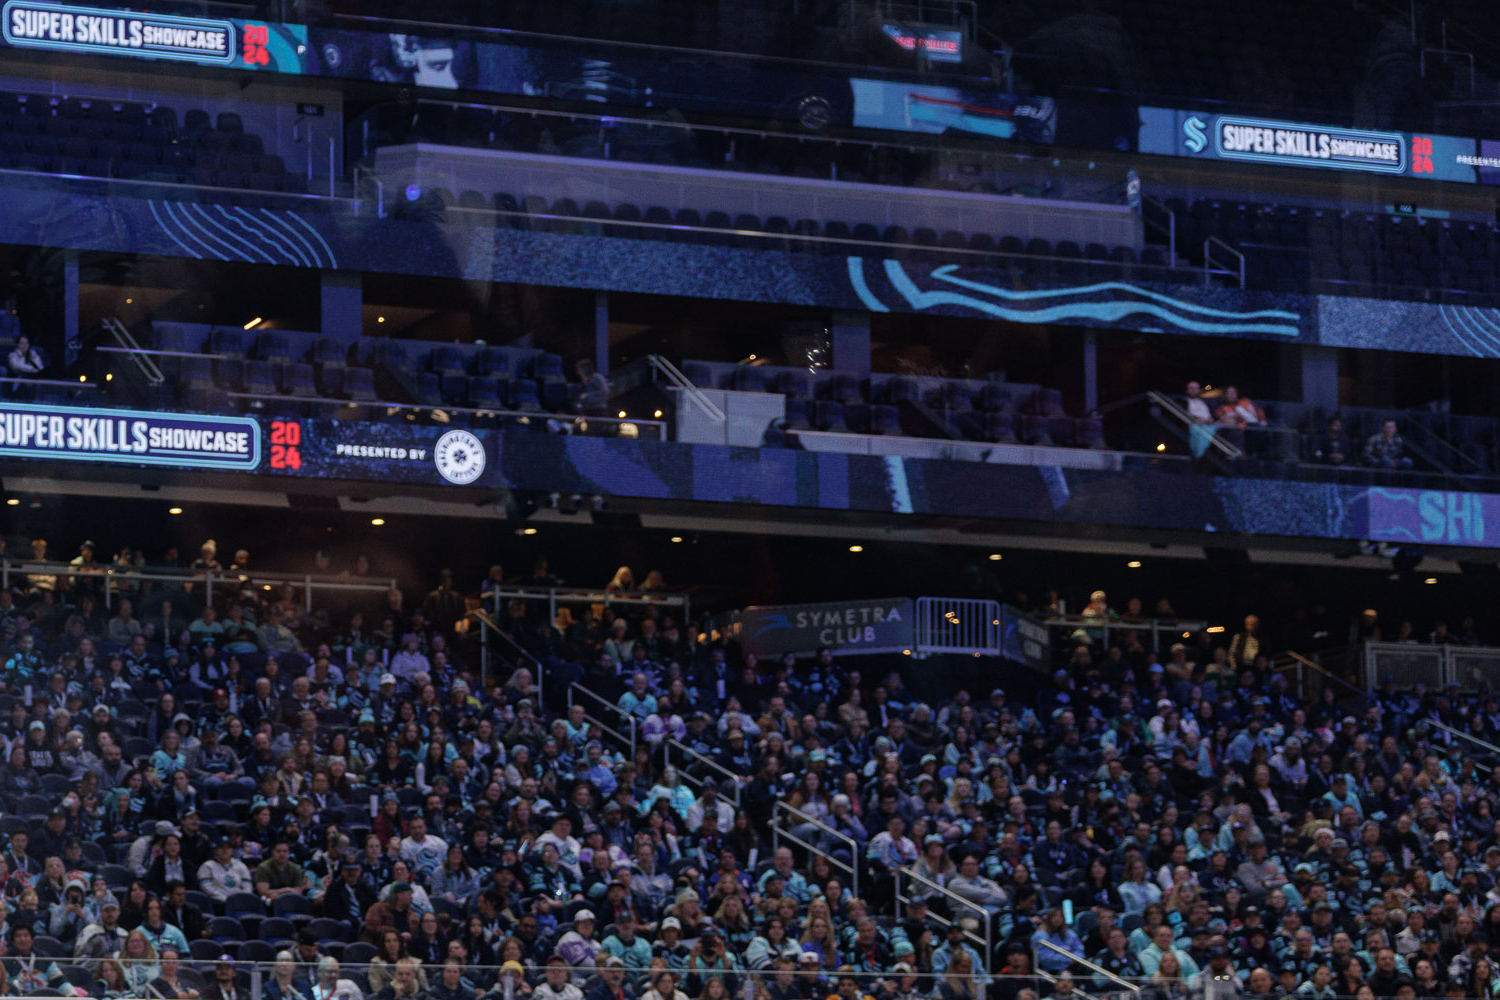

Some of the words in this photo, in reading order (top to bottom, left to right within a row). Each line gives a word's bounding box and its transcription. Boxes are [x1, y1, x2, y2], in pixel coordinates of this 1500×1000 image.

[12, 9, 74, 42] SUPER
[75, 16, 143, 47] SKILLS
[143, 25, 225, 51] SHOWCASE
[243, 24, 269, 46] 20
[242, 44, 269, 66] 24
[1223, 125, 1275, 153] SUPER
[1275, 130, 1331, 159] SKILLS
[1330, 140, 1398, 161] SHOWCASE
[1412, 136, 1433, 156] 20
[1412, 155, 1434, 174] 24
[67, 416, 148, 453] SKILLS
[149, 426, 248, 453] SHOWCASE
[270, 421, 300, 445] 20
[270, 445, 302, 470] 24
[336, 444, 407, 460] PRESENTED
[409, 448, 426, 461] BY
[796, 606, 902, 629] SYMETRA
[819, 625, 876, 645] CLUB
